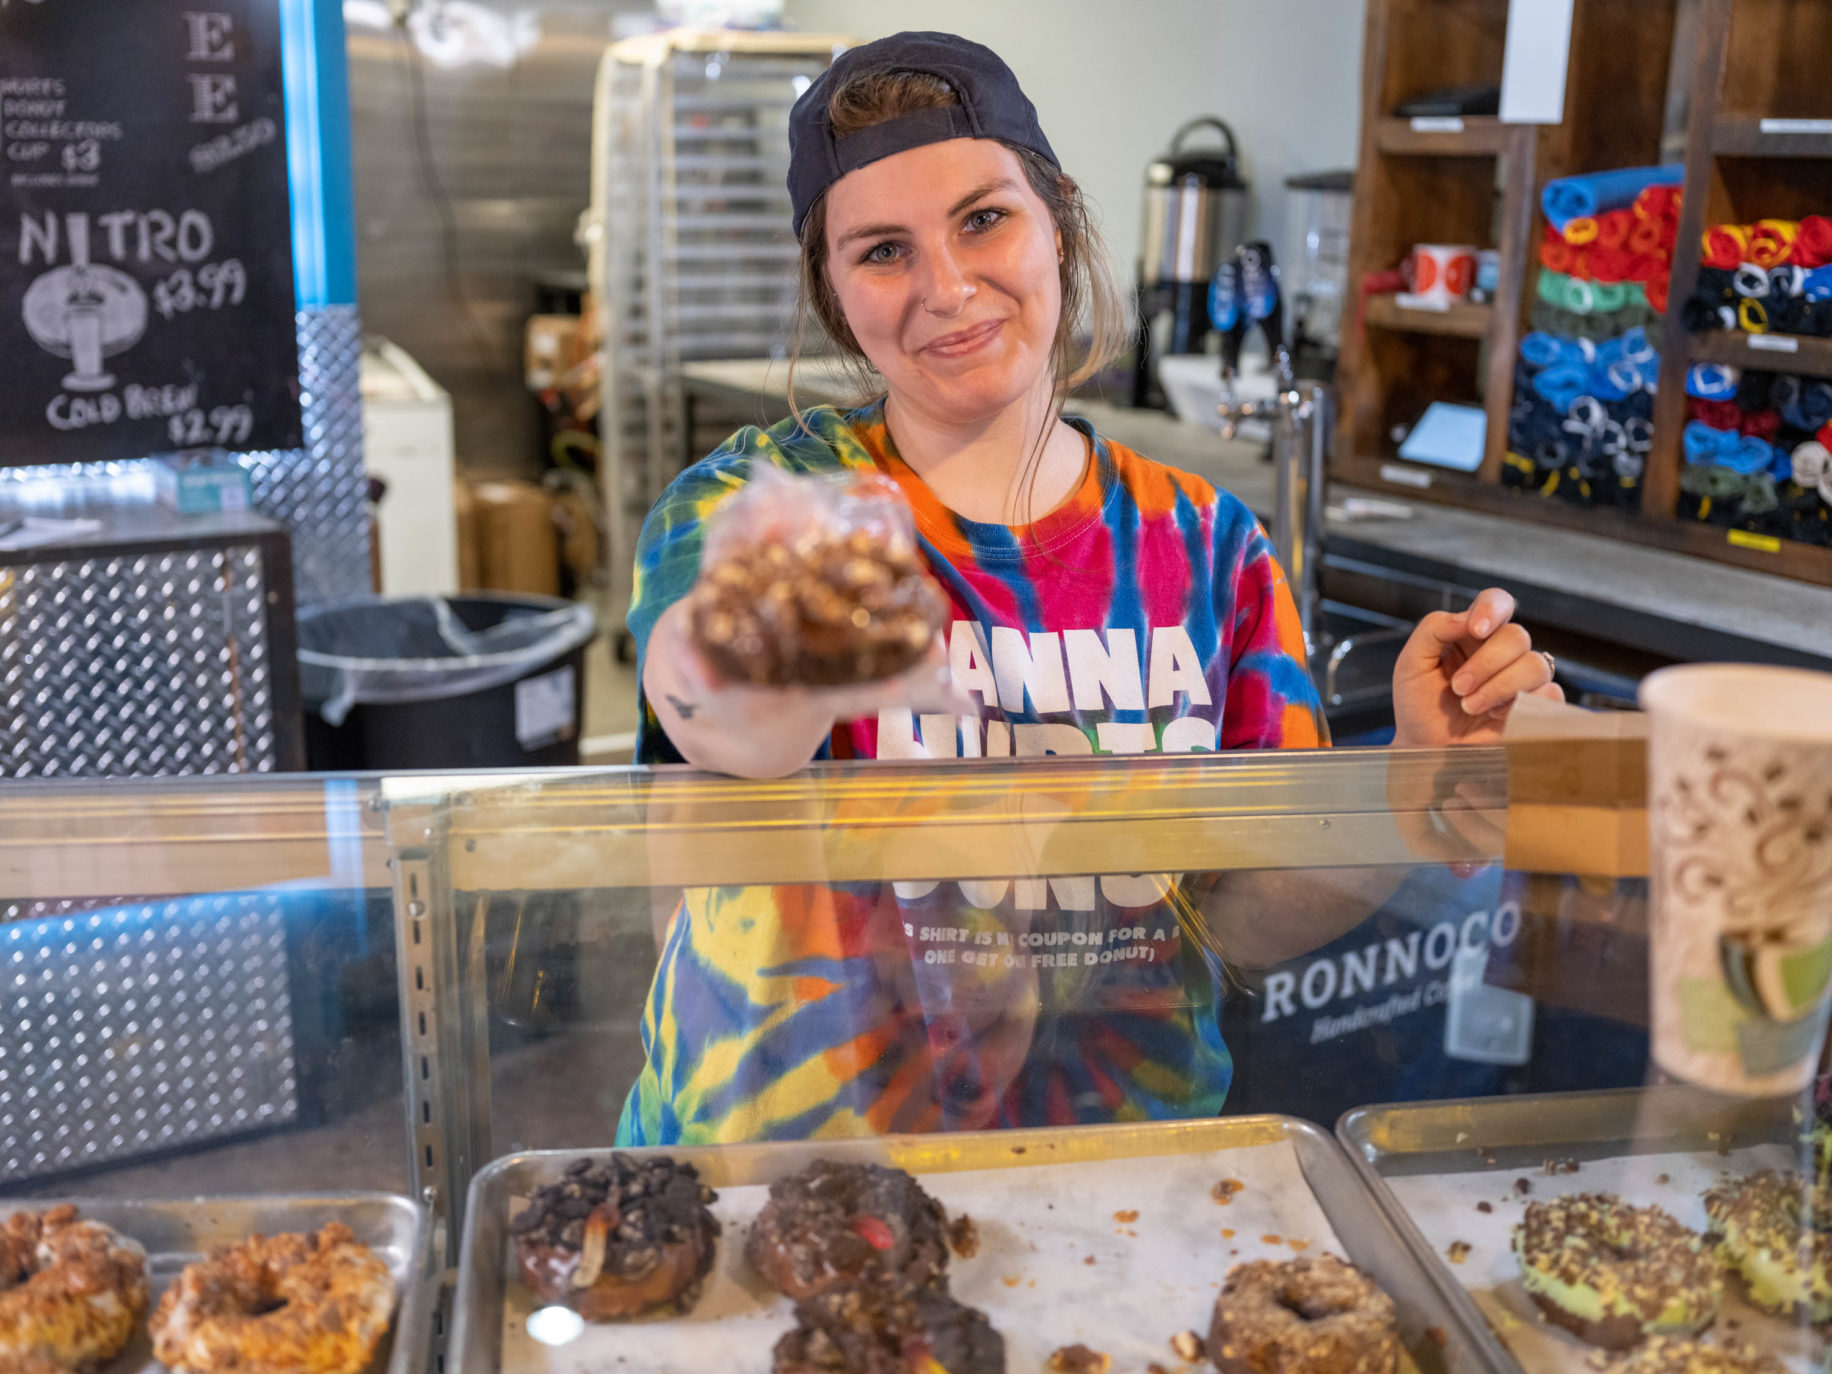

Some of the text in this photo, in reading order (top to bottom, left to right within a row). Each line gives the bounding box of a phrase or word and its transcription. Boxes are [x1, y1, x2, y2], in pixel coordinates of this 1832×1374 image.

[19, 208, 213, 265] NITRO
[46, 393, 122, 430] COLD
[940, 619, 1213, 714] ANNA
[919, 926, 969, 942] SHIRT
[974, 931, 992, 946] IS
[1018, 931, 1103, 947] COUPON
[1108, 926, 1145, 943] FOR
[1153, 928, 1166, 941] A
[924, 949, 955, 965] ONE
[961, 950, 999, 968] GET
[1031, 952, 1077, 968] FREE
[1084, 945, 1155, 967] DONUT)
[1261, 900, 1522, 1024] RONNOCO
